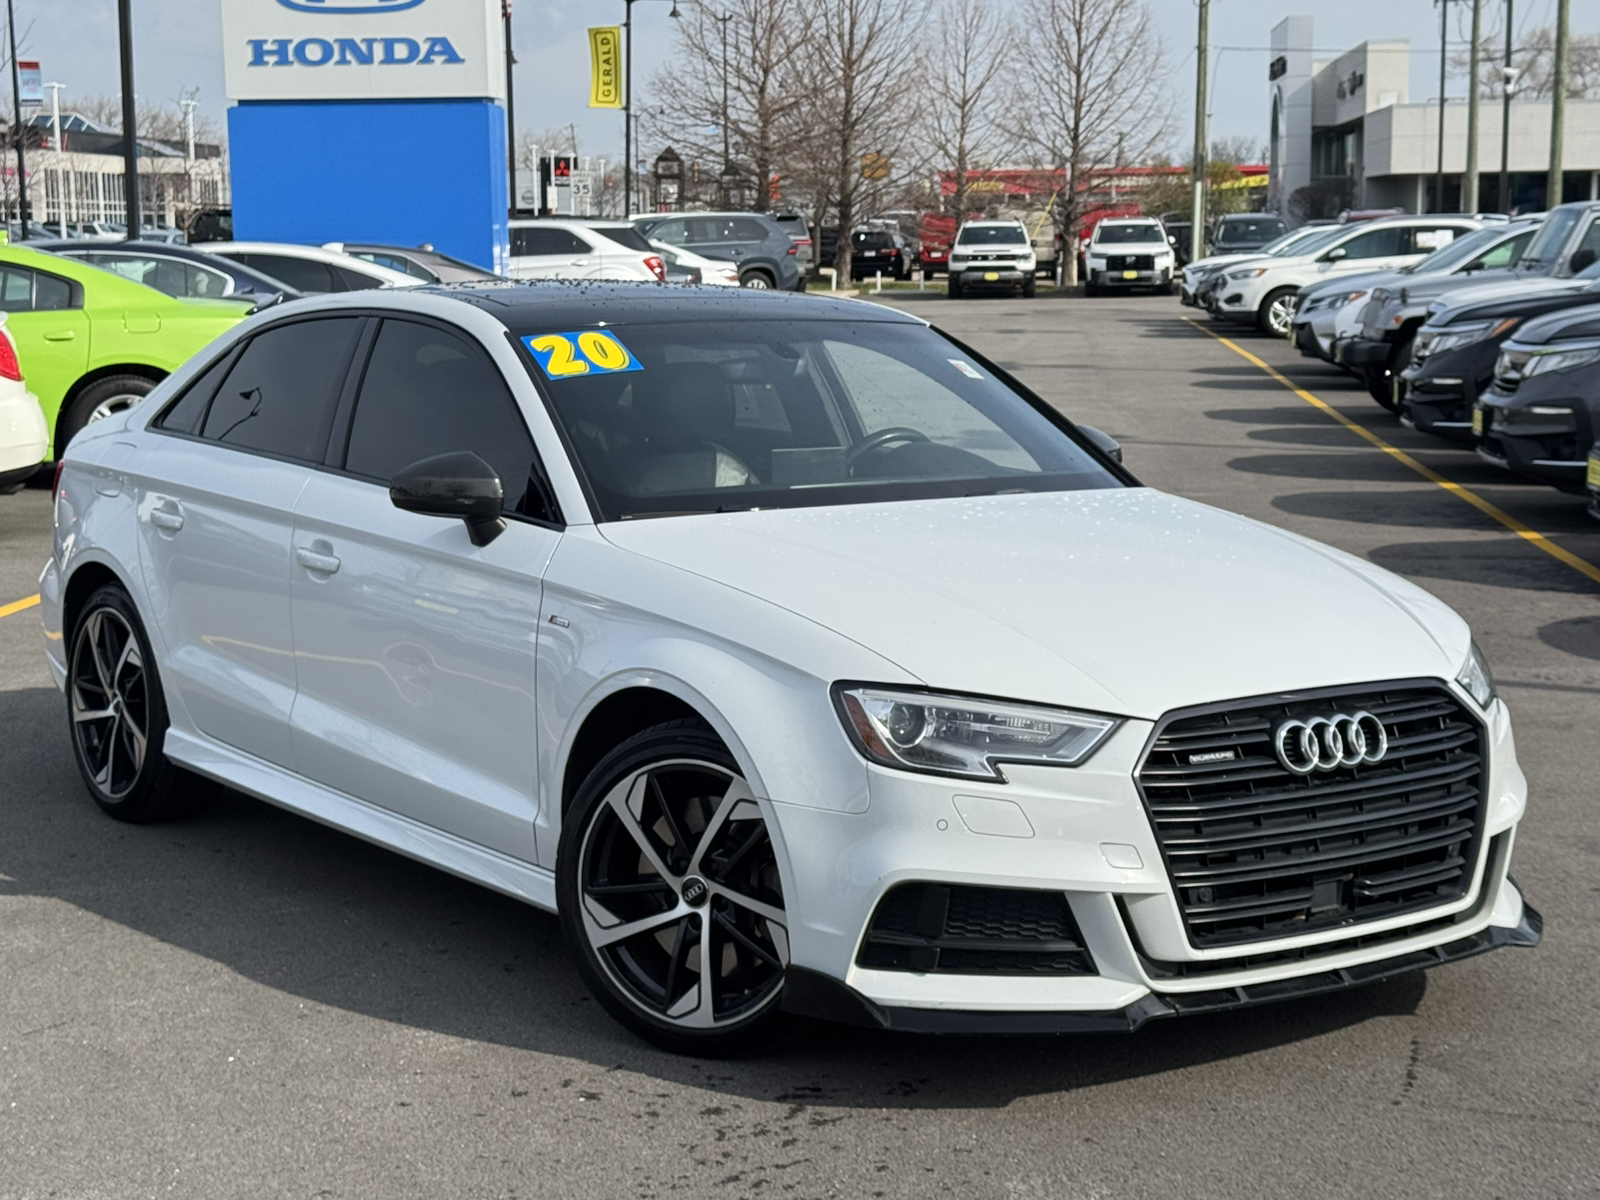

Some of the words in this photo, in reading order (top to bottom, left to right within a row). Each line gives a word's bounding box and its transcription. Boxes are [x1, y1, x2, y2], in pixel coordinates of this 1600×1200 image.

[246, 36, 466, 67] HONDA
[601, 37, 613, 98] GERALD
[573, 184, 591, 195] 35
[530, 332, 630, 376] 20
